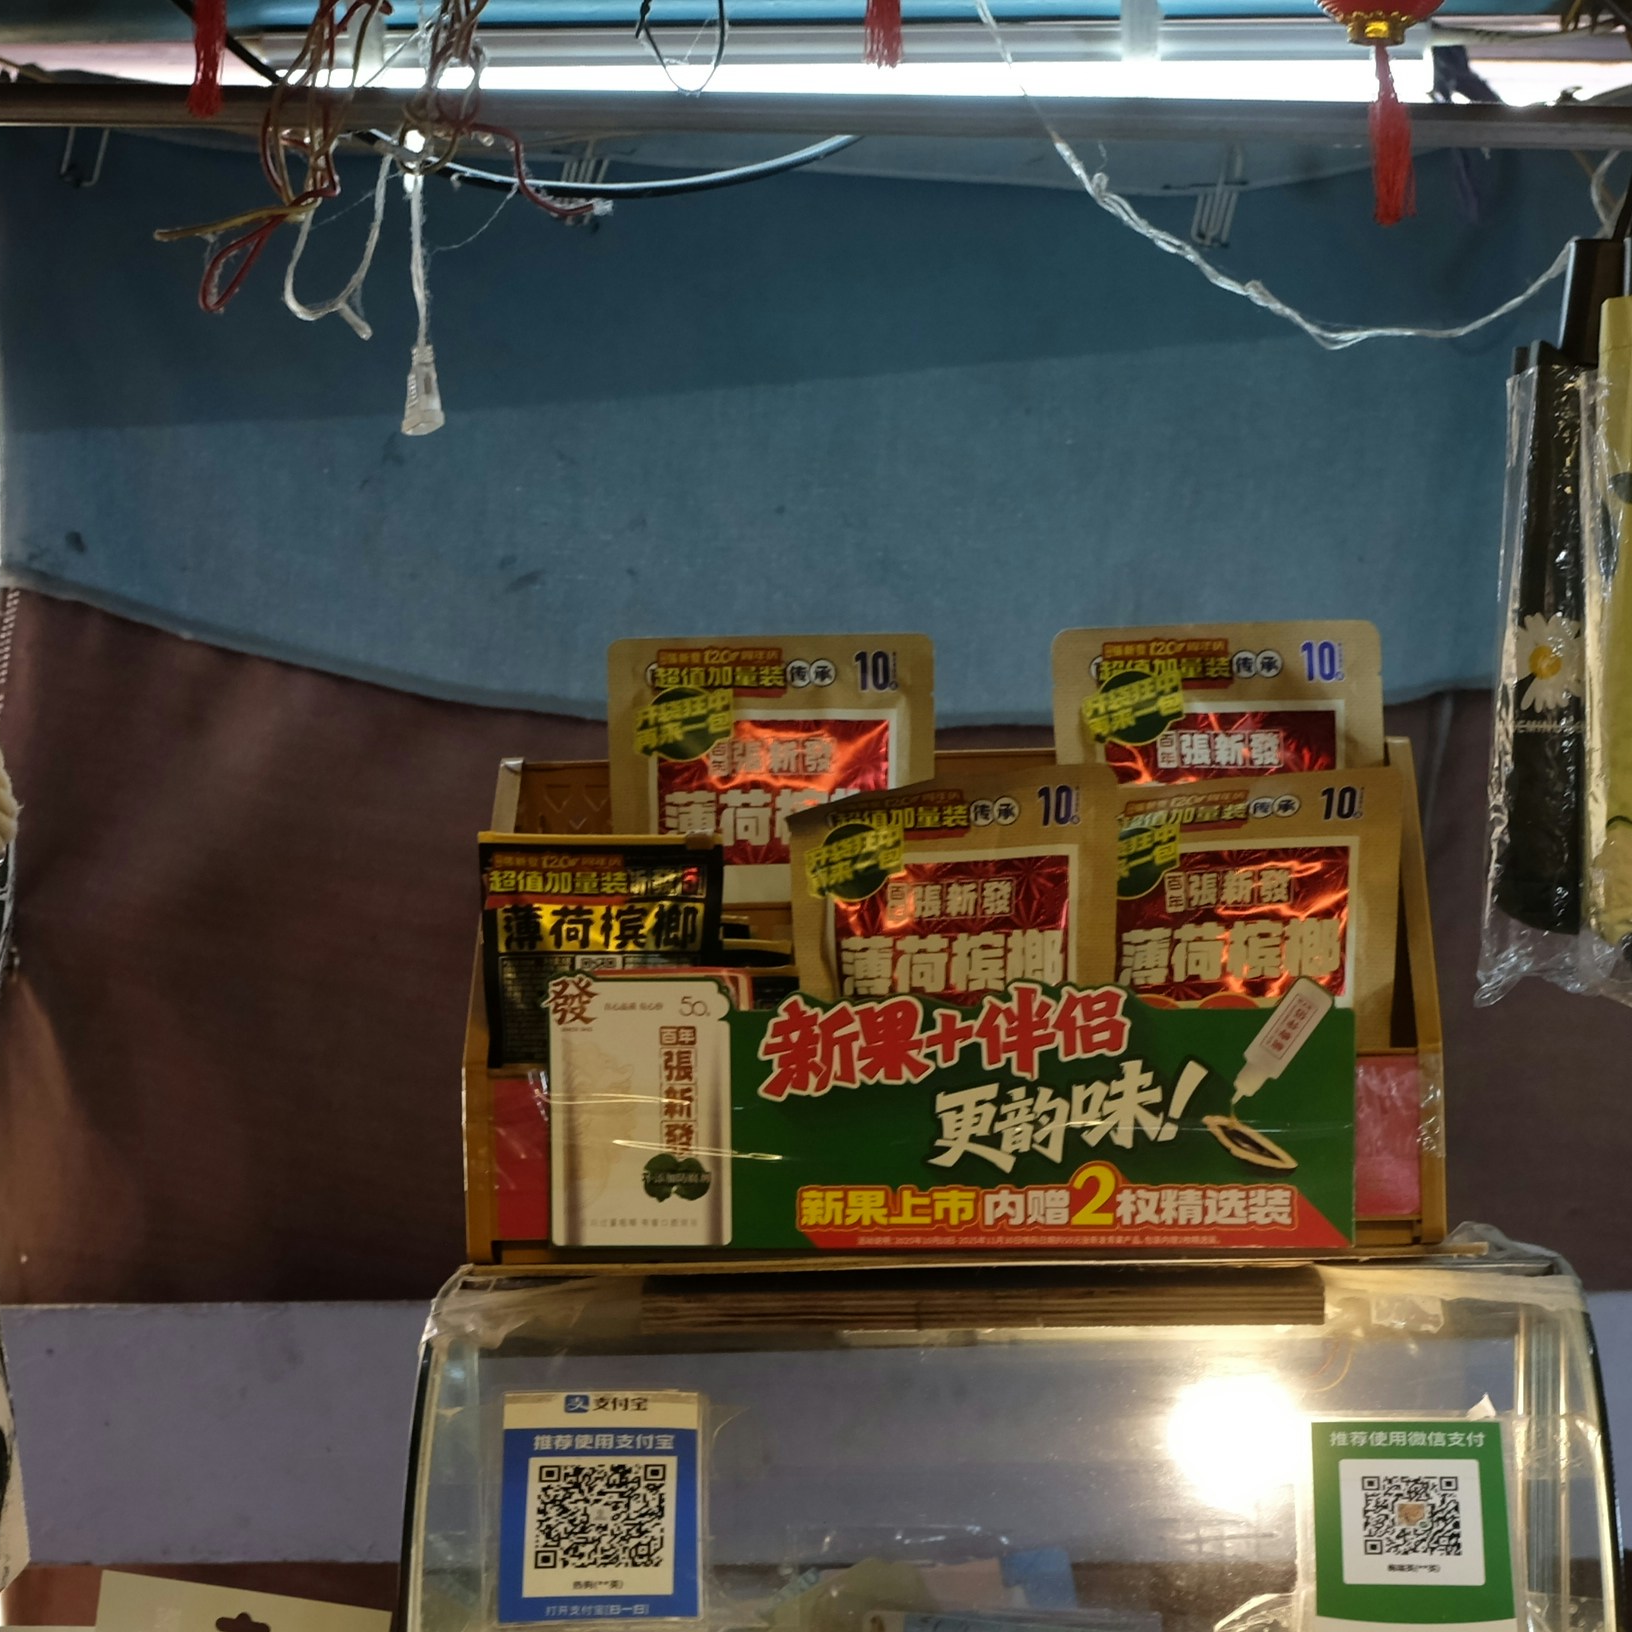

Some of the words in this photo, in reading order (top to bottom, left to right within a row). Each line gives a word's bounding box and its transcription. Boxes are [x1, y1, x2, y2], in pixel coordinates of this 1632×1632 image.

[855, 650, 891, 692] 10
[1301, 640, 1338, 682] 10
[1038, 785, 1073, 827] 10
[1322, 786, 1356, 820] 10
[489, 870, 629, 894] 超值加量装
[503, 903, 700, 950] 薄荷槟榔
[840, 925, 1065, 997] 薄荷槟榔
[1118, 918, 1342, 987] 薄荷槟榔
[660, 1026, 697, 1046] 百年
[760, 980, 1130, 1100] 新果+伴侣
[663, 1049, 694, 1156] 張新發
[799, 1189, 979, 1227] 新果上市
[984, 1162, 1294, 1228] 内赠2枚精选装
[592, 1396, 649, 1412] 支付宝
[533, 1433, 676, 1451] 推荐使用支付宝
[1328, 1430, 1487, 1449] 推荐使用微信支付
